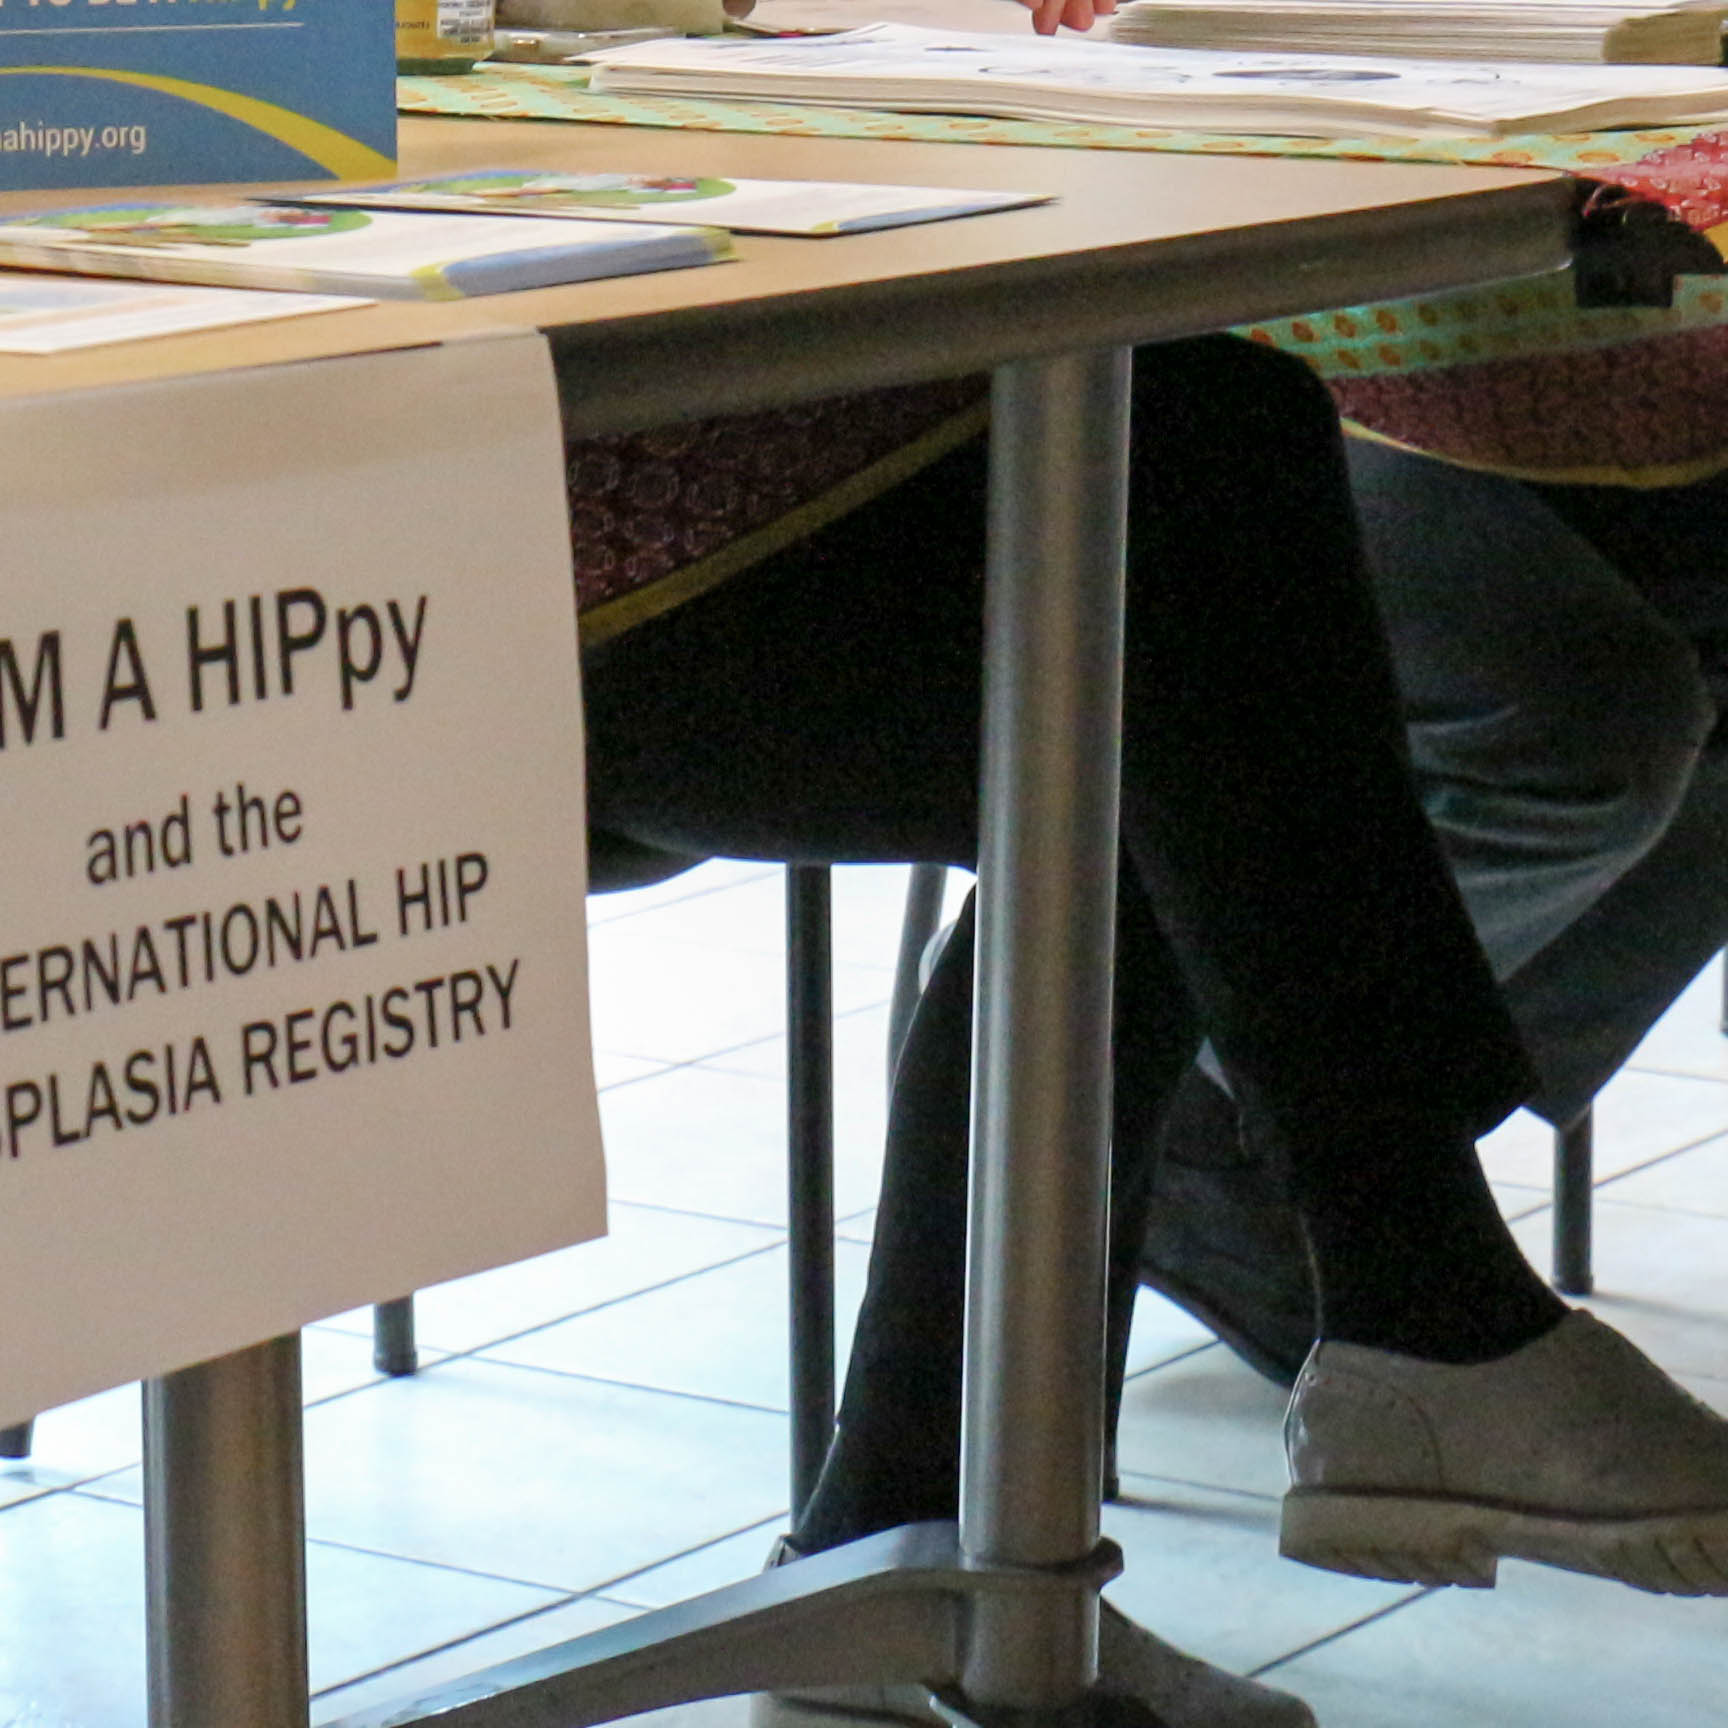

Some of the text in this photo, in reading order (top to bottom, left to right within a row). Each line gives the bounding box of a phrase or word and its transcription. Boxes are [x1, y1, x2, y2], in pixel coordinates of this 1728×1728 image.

[98, 617, 157, 731] A
[186, 586, 429, 712] HIPpy
[85, 782, 304, 886] and the
[395, 850, 491, 938] HIP
[240, 957, 522, 1096] REGISTRY
